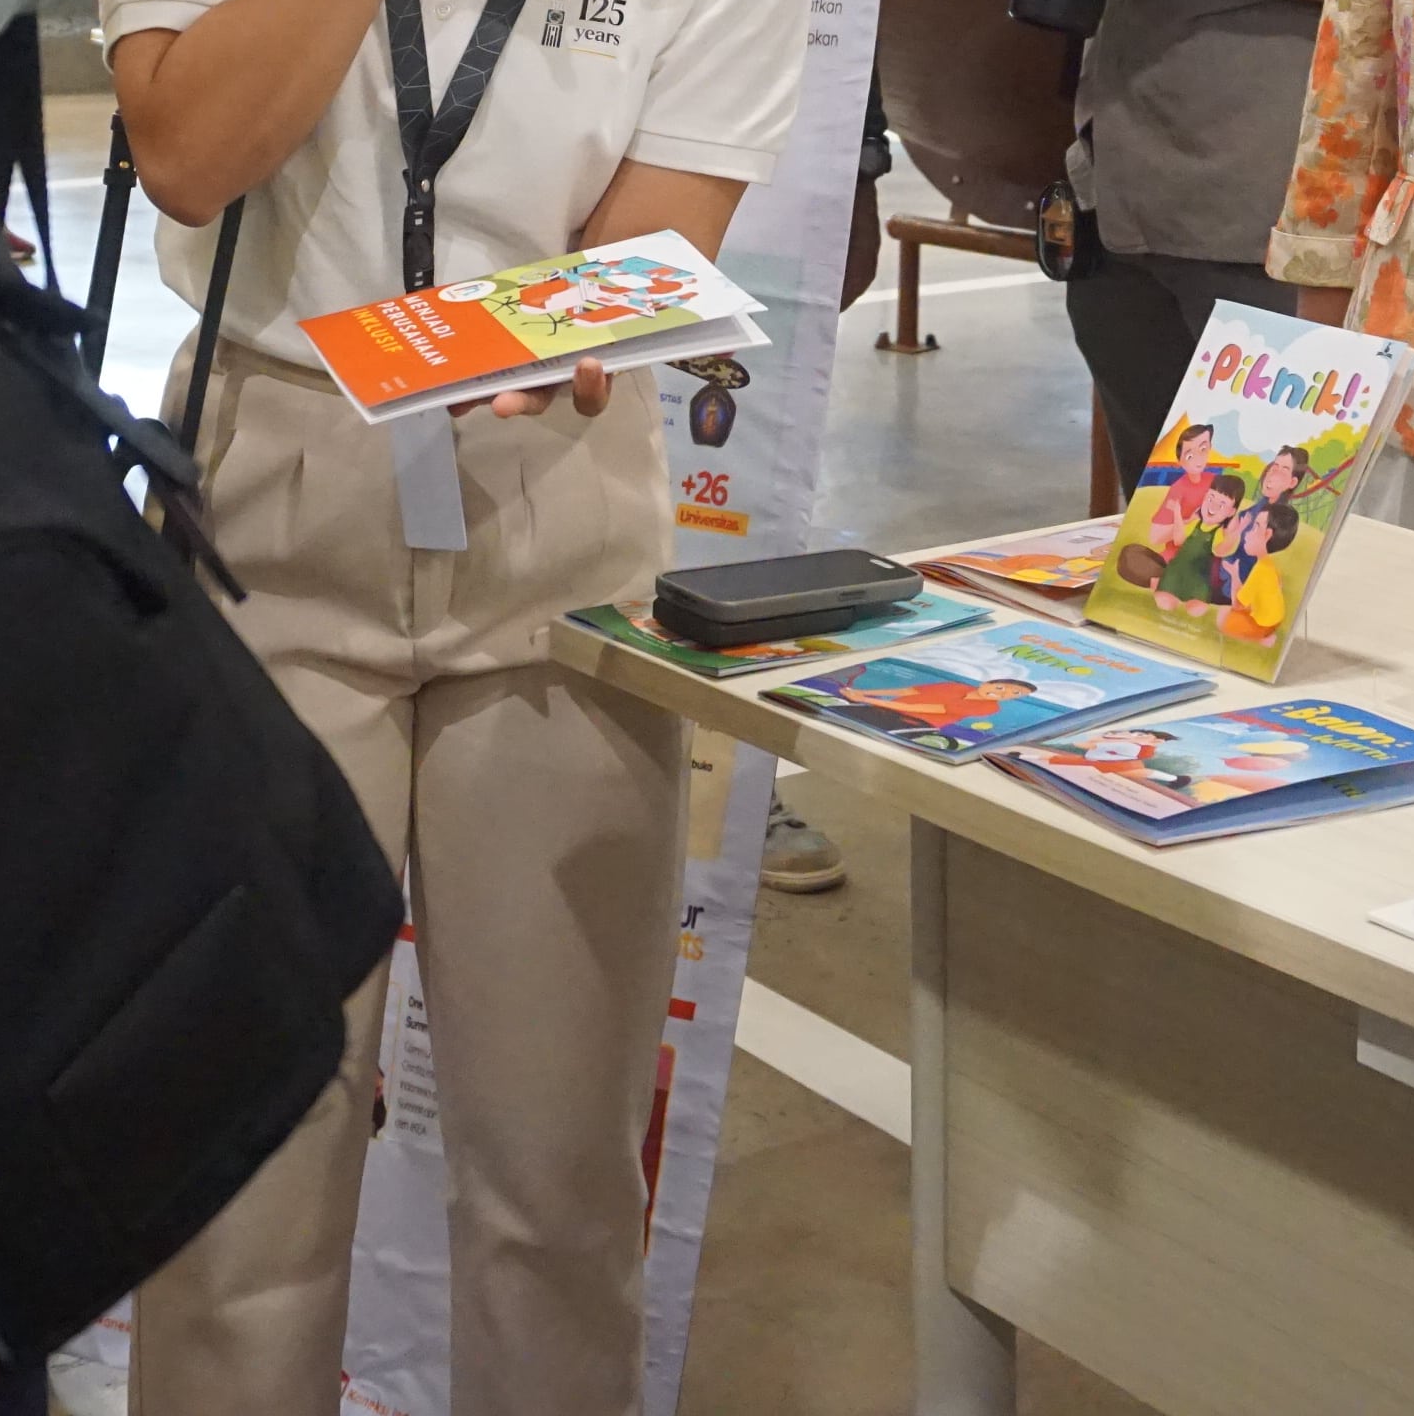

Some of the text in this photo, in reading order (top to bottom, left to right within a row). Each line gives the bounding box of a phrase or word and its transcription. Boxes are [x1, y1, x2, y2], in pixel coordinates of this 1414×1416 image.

[573, 27, 621, 46] years
[350, 308, 404, 353] INKLUSIF
[377, 301, 449, 366] PERUSAHAAN
[403, 295, 456, 339] MENJADI
[1207, 343, 1362, 421] Piknik!
[682, 470, 730, 506] +26
[679, 509, 740, 532] Universitas
[1281, 705, 1396, 746] Balon
